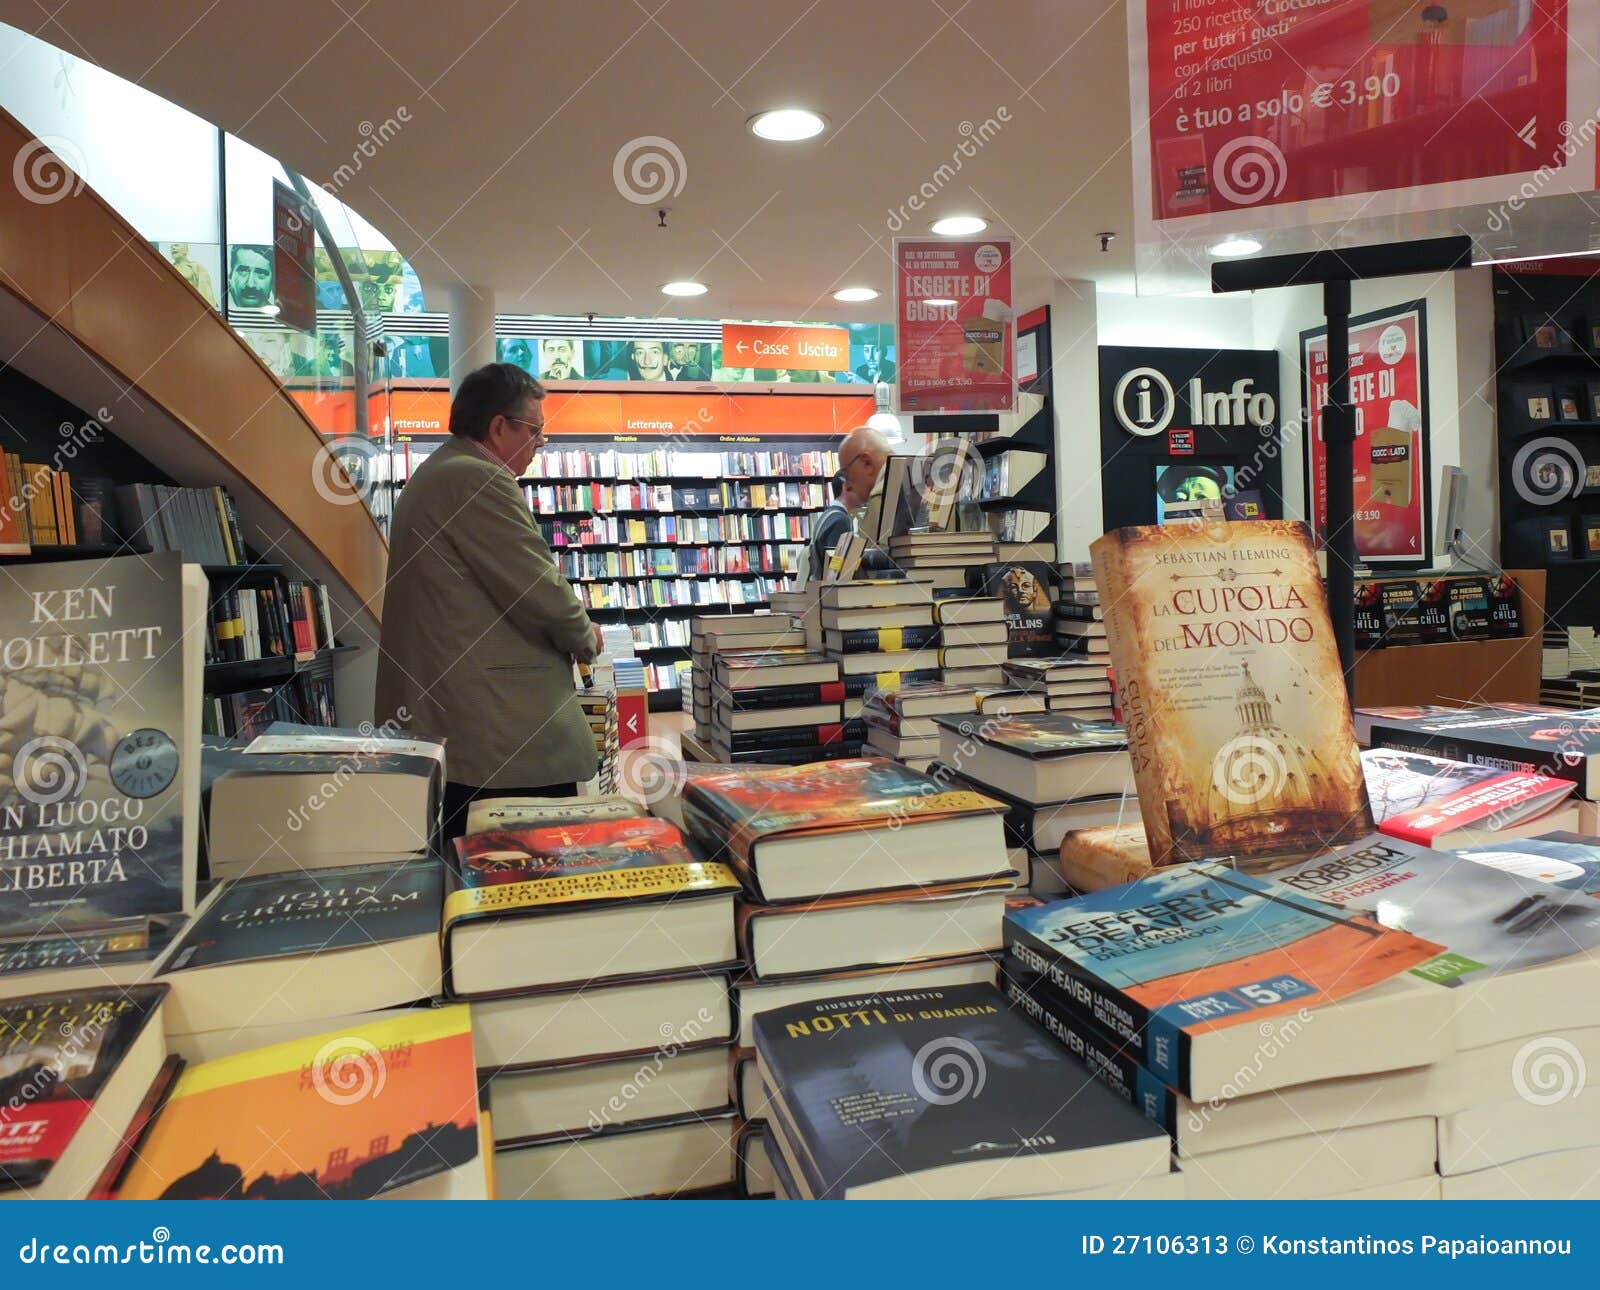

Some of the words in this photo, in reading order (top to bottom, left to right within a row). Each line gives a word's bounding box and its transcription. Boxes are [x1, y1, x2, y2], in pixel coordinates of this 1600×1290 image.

[1173, 16, 1201, 35] 250
[1206, 8, 1252, 28] ricette
[1174, 41, 1197, 59] per
[1203, 29, 1236, 49] tutti
[1240, 26, 1246, 42] i
[1174, 60, 1199, 78] con
[1204, 47, 1272, 72] l'acquisto
[1175, 79, 1187, 99] di
[1193, 80, 1201, 96] 2
[1206, 74, 1232, 94] libri
[1176, 107, 1190, 132] è
[1193, 105, 1233, 129] tuo
[1238, 103, 1251, 121] a
[1256, 89, 1304, 119] solo
[1311, 83, 1335, 108] €
[1341, 71, 1401, 105] 3,90
[906, 275, 969, 297] LEGGETE
[974, 275, 991, 297] DI
[906, 300, 959, 322] GUSTO
[753, 340, 790, 356] Casse
[798, 341, 839, 358] Uscita
[1379, 367, 1396, 399] DI
[1190, 377, 1276, 427] Info
[627, 419, 674, 430] Letteratura
[1356, 511, 1364, 521] €
[1364, 510, 1380, 521] 3,90
[1154, 551, 1227, 565] SEBASTIAN
[1233, 548, 1290, 562] FLEMING
[30, 586, 116, 624] KEN
[1153, 603, 1171, 616] LA
[1172, 585, 1308, 615] CUPOLA
[1426, 607, 1438, 616] LEE
[1493, 610, 1517, 620] CHILD
[1498, 603, 1510, 611] LEE
[1006, 618, 1044, 630] OLLINS
[1358, 612, 1371, 620] LEE
[1420, 614, 1446, 625] CHILD
[0, 626, 162, 671] OLLETT
[1154, 637, 1178, 652] DEL
[1180, 617, 1314, 650] MONDO
[1476, 755, 1536, 775] SUGGERITORE
[37, 797, 144, 829] LUOGO
[0, 825, 149, 859] HIAMATO
[0, 854, 128, 892] LIBERTÀ
[1278, 842, 1384, 884] ROBERT
[1289, 847, 1405, 891] LUDLUM
[273, 885, 377, 905] JOHN
[480, 895, 539, 905] SOTTO
[547, 890, 574, 898] GLI
[582, 884, 638, 894] OCCHI
[497, 878, 578, 893] SEGRETO
[538, 882, 604, 894] STORIA
[1320, 890, 1344, 900] LA
[1344, 871, 1394, 893] PREDA
[1351, 871, 1418, 900] BOURNE
[220, 891, 420, 923] GRISHAM
[1049, 888, 1211, 944] JEFFERY
[1070, 898, 1242, 951] DEAVER
[1086, 944, 1105, 958] LA
[1118, 928, 1193, 951] STRADA
[1094, 941, 1158, 962] DELLE
[1162, 925, 1225, 951] CROCI
[1011, 939, 1049, 981] JEFFERY
[1049, 964, 1092, 1011] DEAVER
[1093, 990, 1104, 1006] LA
[1104, 999, 1134, 1029] STRADA
[815, 994, 880, 1011] GIUSEPPE
[784, 1006, 888, 1039] NOTTI
[894, 1012, 912, 1024] DI
[918, 1003, 996, 1022] GUARDIA
[1008, 983, 1044, 1024] JEFFERY
[1044, 1010, 1084, 1056] DEAVER
[1085, 1042, 1096, 1058] LA
[1095, 1050, 1124, 1081] STRADA
[1093, 1007, 1117, 1033] DELLE
[1116, 1020, 1142, 1049] CROCI
